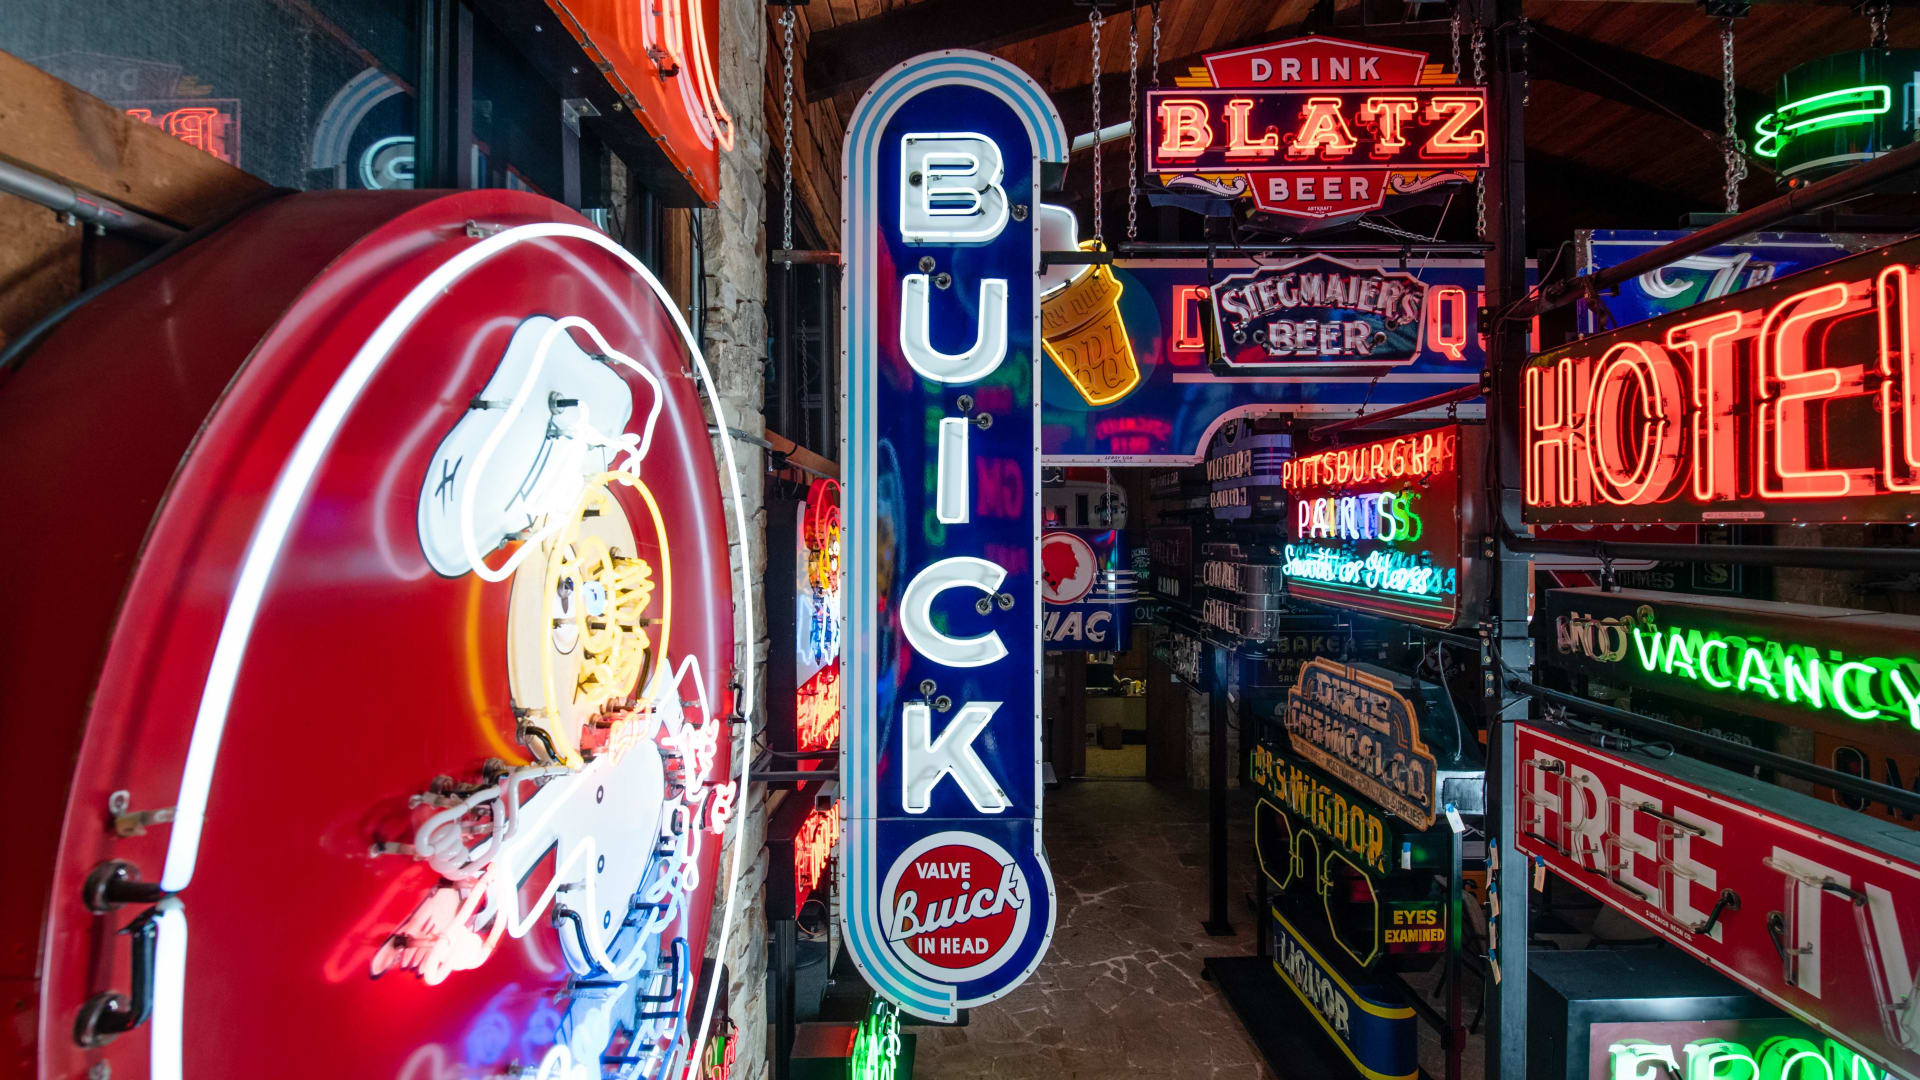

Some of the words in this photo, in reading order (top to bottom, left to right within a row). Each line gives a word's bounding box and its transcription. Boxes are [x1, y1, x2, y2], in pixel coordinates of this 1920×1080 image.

[1252, 57, 1382, 82] DRINK
[1157, 97, 1486, 164] BLATZ
[1269, 177, 1370, 200] BEER
[1221, 273, 1420, 328] STEGMAIER'S
[1268, 320, 1373, 356] BEER
[899, 131, 1015, 814] BUICK
[1282, 434, 1446, 489] PITTSBURGH
[1298, 492, 1420, 542] PAINTS
[1044, 611, 1113, 643] IAC
[1634, 626, 1920, 732] VACANCY
[1524, 748, 1723, 945] FREE
[916, 863, 971, 879] VALVE
[889, 862, 1025, 942] Buick
[1393, 909, 1437, 925] EYES
[918, 938, 936, 954] IN
[940, 938, 989, 954] HEAD
[1384, 928, 1445, 943] EXAMINED
